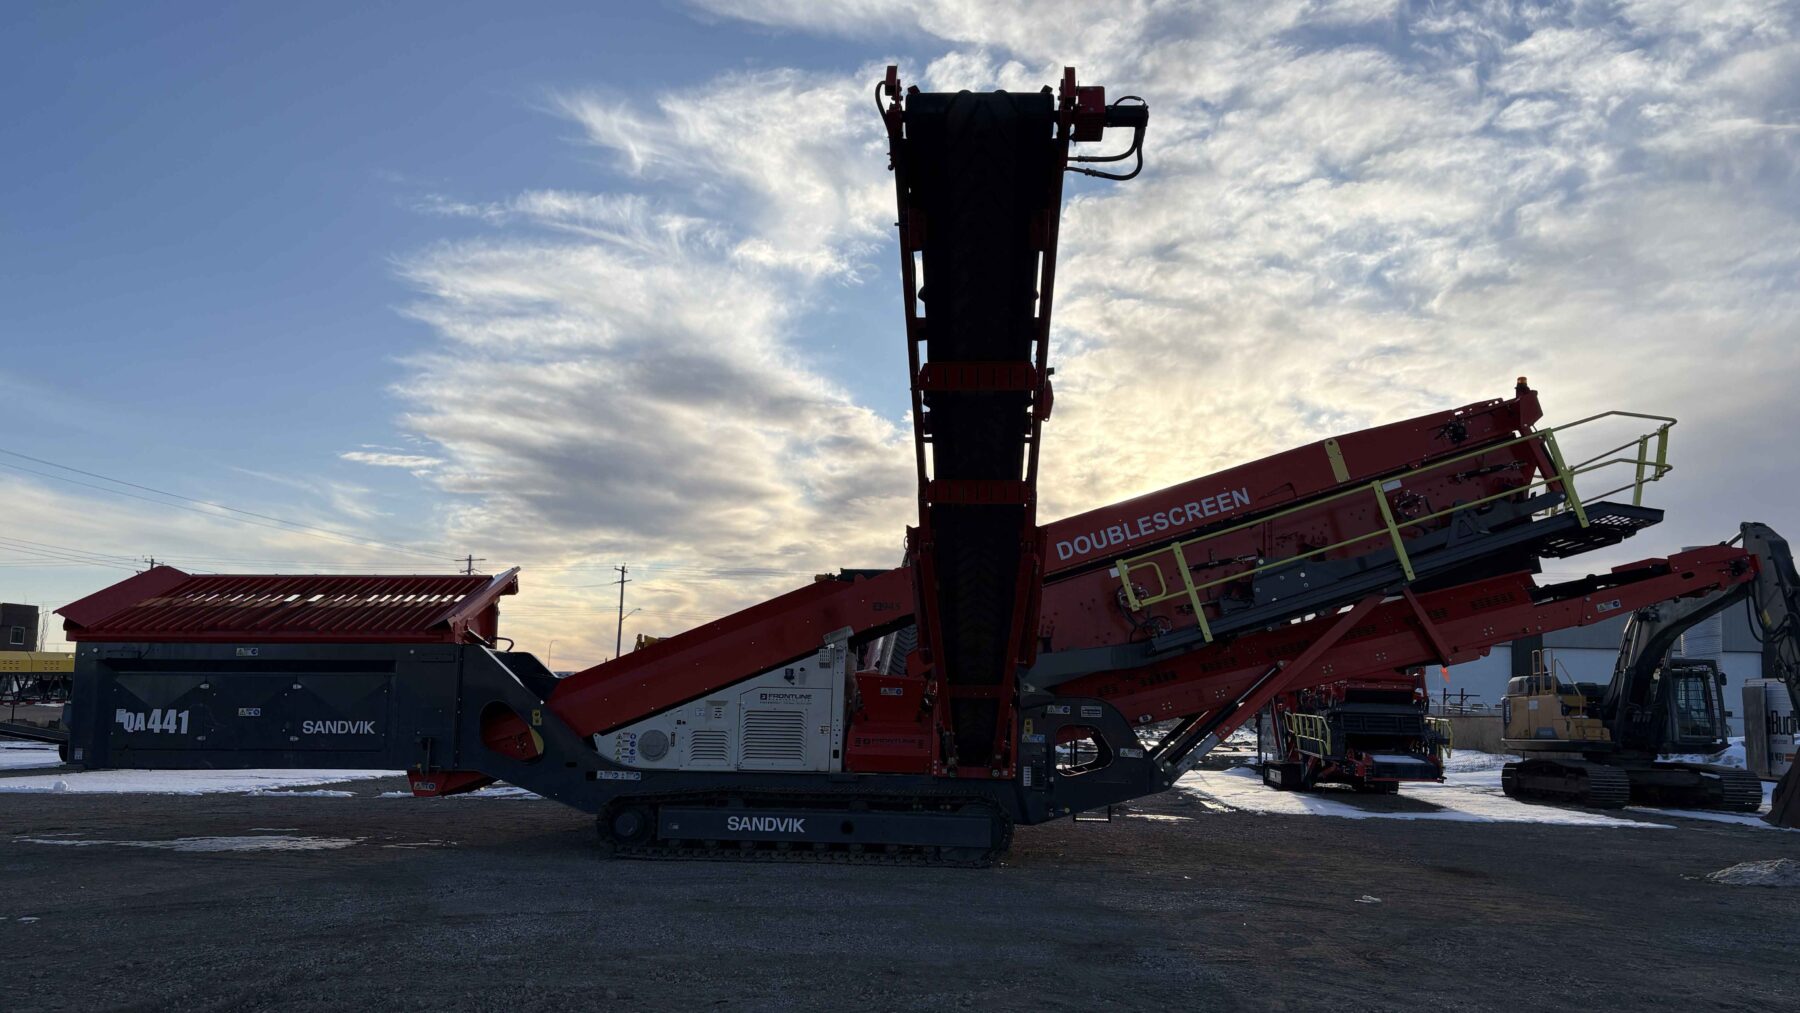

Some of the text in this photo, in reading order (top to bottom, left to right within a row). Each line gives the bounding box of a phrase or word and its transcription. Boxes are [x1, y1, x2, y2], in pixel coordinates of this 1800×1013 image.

[1056, 487, 1250, 561] DOUBLESCREEN
[302, 720, 377, 735] SANDVIK
[727, 815, 806, 834] SANDVIK
